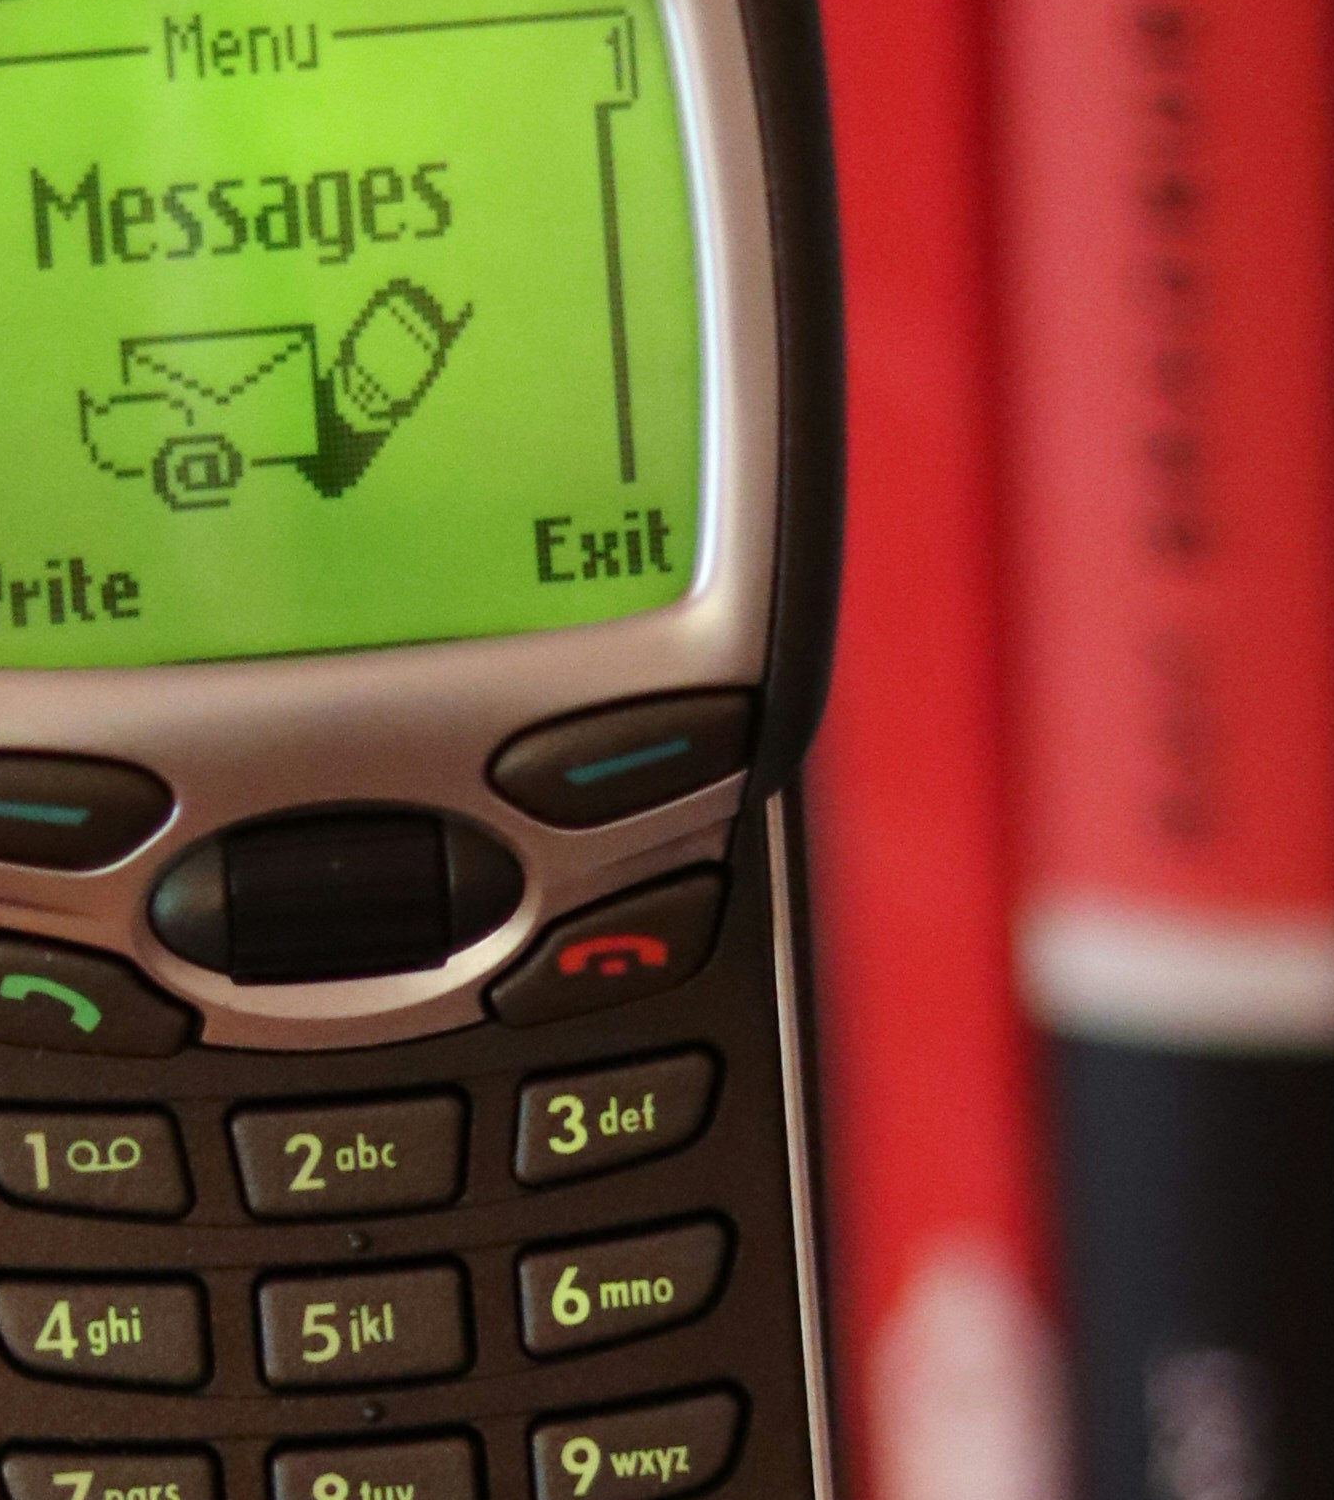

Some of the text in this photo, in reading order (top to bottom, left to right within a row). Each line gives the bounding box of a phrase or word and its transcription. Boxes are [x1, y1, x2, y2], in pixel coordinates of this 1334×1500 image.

[162, 14, 319, 83] Menu
[30, 161, 453, 270] Messages
[533, 507, 674, 585] Exit
[547, 1092, 657, 1156] 3 def
[24, 1132, 51, 1192] 1
[284, 1132, 398, 1193] 2 abc
[551, 1265, 675, 1327] 6 mno
[33, 1299, 143, 1362] 4 ghi
[301, 1302, 395, 1364] 5 jkl
[560, 1436, 691, 1497] 9 wxyz
